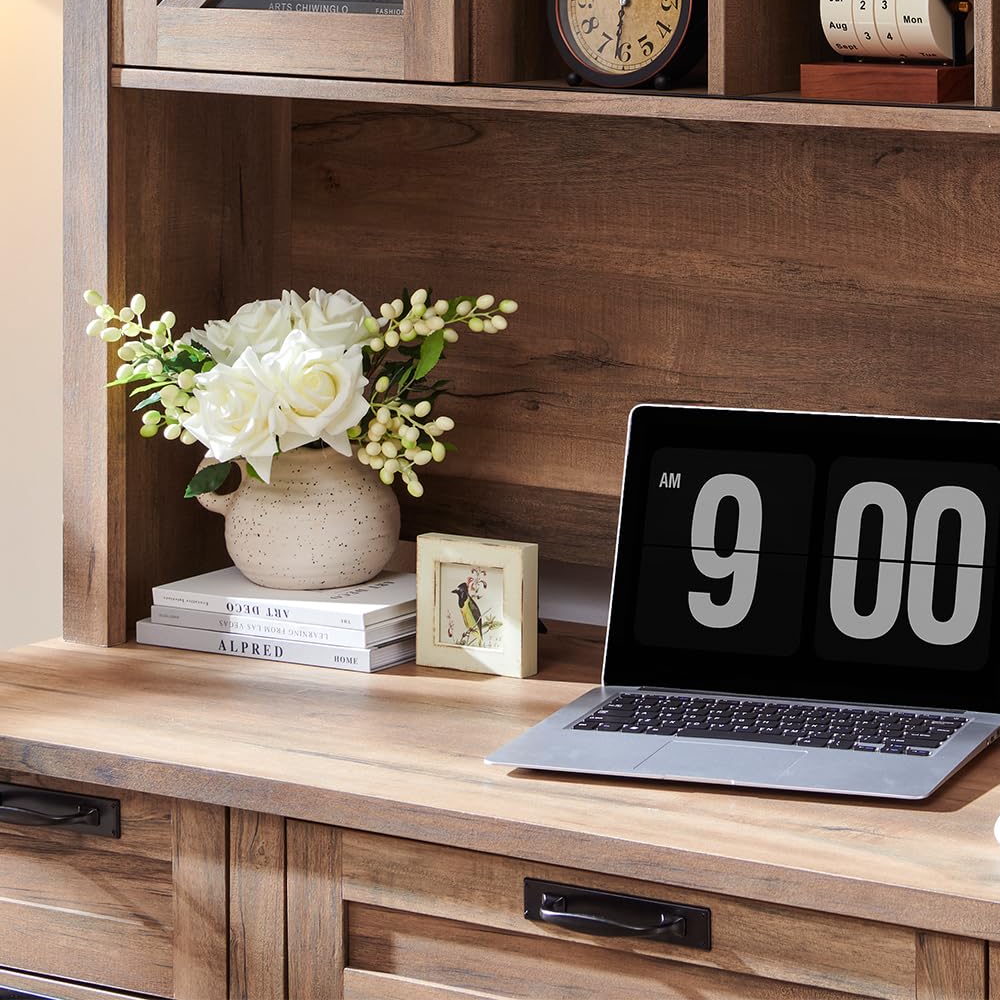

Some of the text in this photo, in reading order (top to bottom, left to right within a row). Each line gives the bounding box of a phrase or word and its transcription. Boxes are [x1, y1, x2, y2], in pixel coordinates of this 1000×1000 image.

[268, 2, 293, 13] ARTS
[859, 0, 888, 10] 2 3
[582, 16, 600, 35] 8
[829, 21, 848, 31] Aug
[903, 15, 923, 24] Mon
[655, 19, 672, 39] 4
[864, 32, 893, 41] 3 4
[597, 31, 613, 54] 7
[637, 34, 654, 57] 5
[617, 42, 632, 63] 6
[658, 472, 681, 489] AM
[687, 472, 987, 646] 9 00
[226, 601, 260, 616] DECO
[265, 606, 290, 619] ART
[218, 619, 329, 640] LEARNING FROM LAS VEGAS
[218, 639, 359, 665] ALPRED HOME
